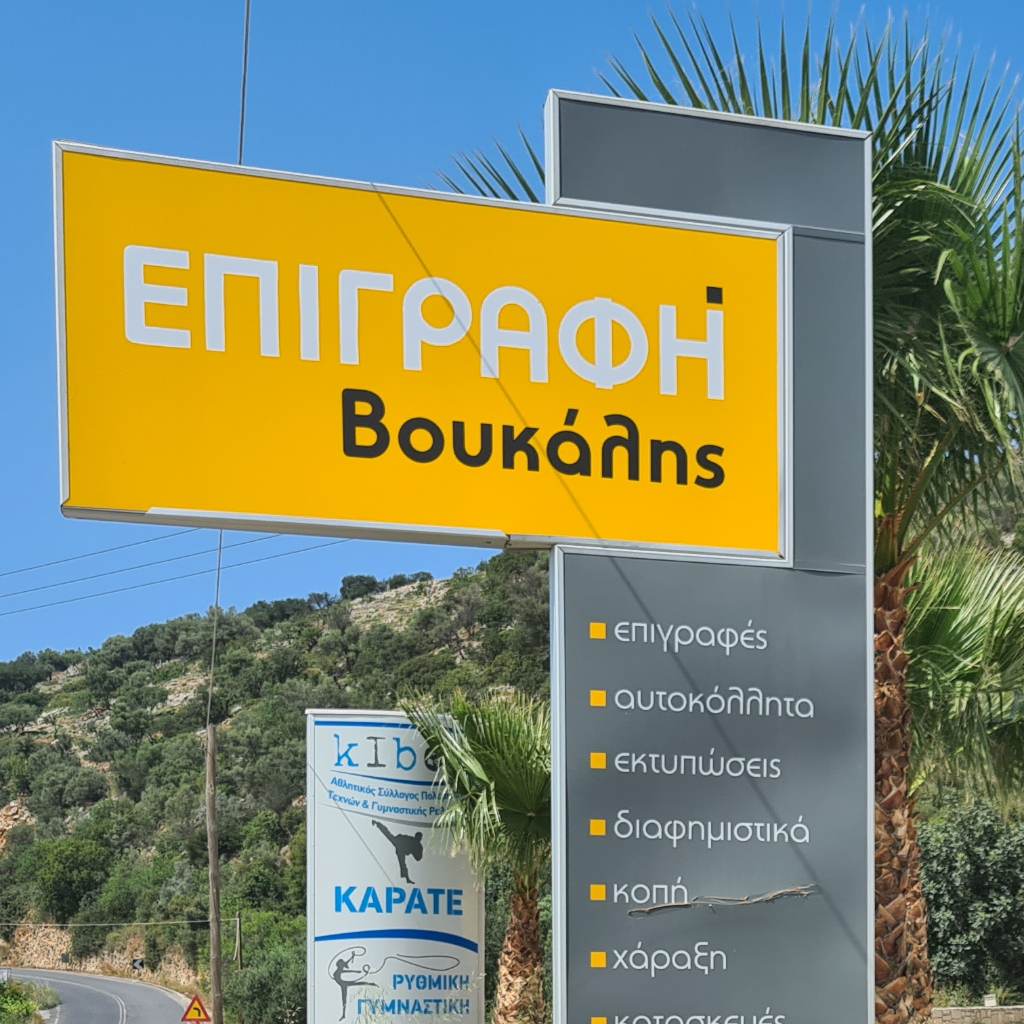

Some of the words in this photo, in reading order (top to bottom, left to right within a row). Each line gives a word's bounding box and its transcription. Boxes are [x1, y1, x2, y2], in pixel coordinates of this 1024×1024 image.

[340, 388, 726, 490] Βουκάλης
[614, 619, 768, 655] επιγραφές
[614, 685, 815, 718] αυτοκόλλητα
[614, 747, 781, 778] εκτυπώσεις
[327, 790, 361, 807] Τεχνών
[361, 799, 369, 809] &
[371, 800, 428, 817] Γυμναστικής
[330, 777, 376, 797] Αθλητικός
[378, 786, 419, 802] Σύλλογος
[613, 809, 810, 848] διαφημιστικά
[334, 885, 464, 916] ΚΑΡΑΤΕ
[613, 876, 688, 904] κοπή
[613, 941, 727, 977] χάραξη
[393, 974, 470, 991] ΡΥΘΜΙΚΗ
[357, 998, 471, 1016] ΓΥΜΝΑΣΤΙΚΗ
